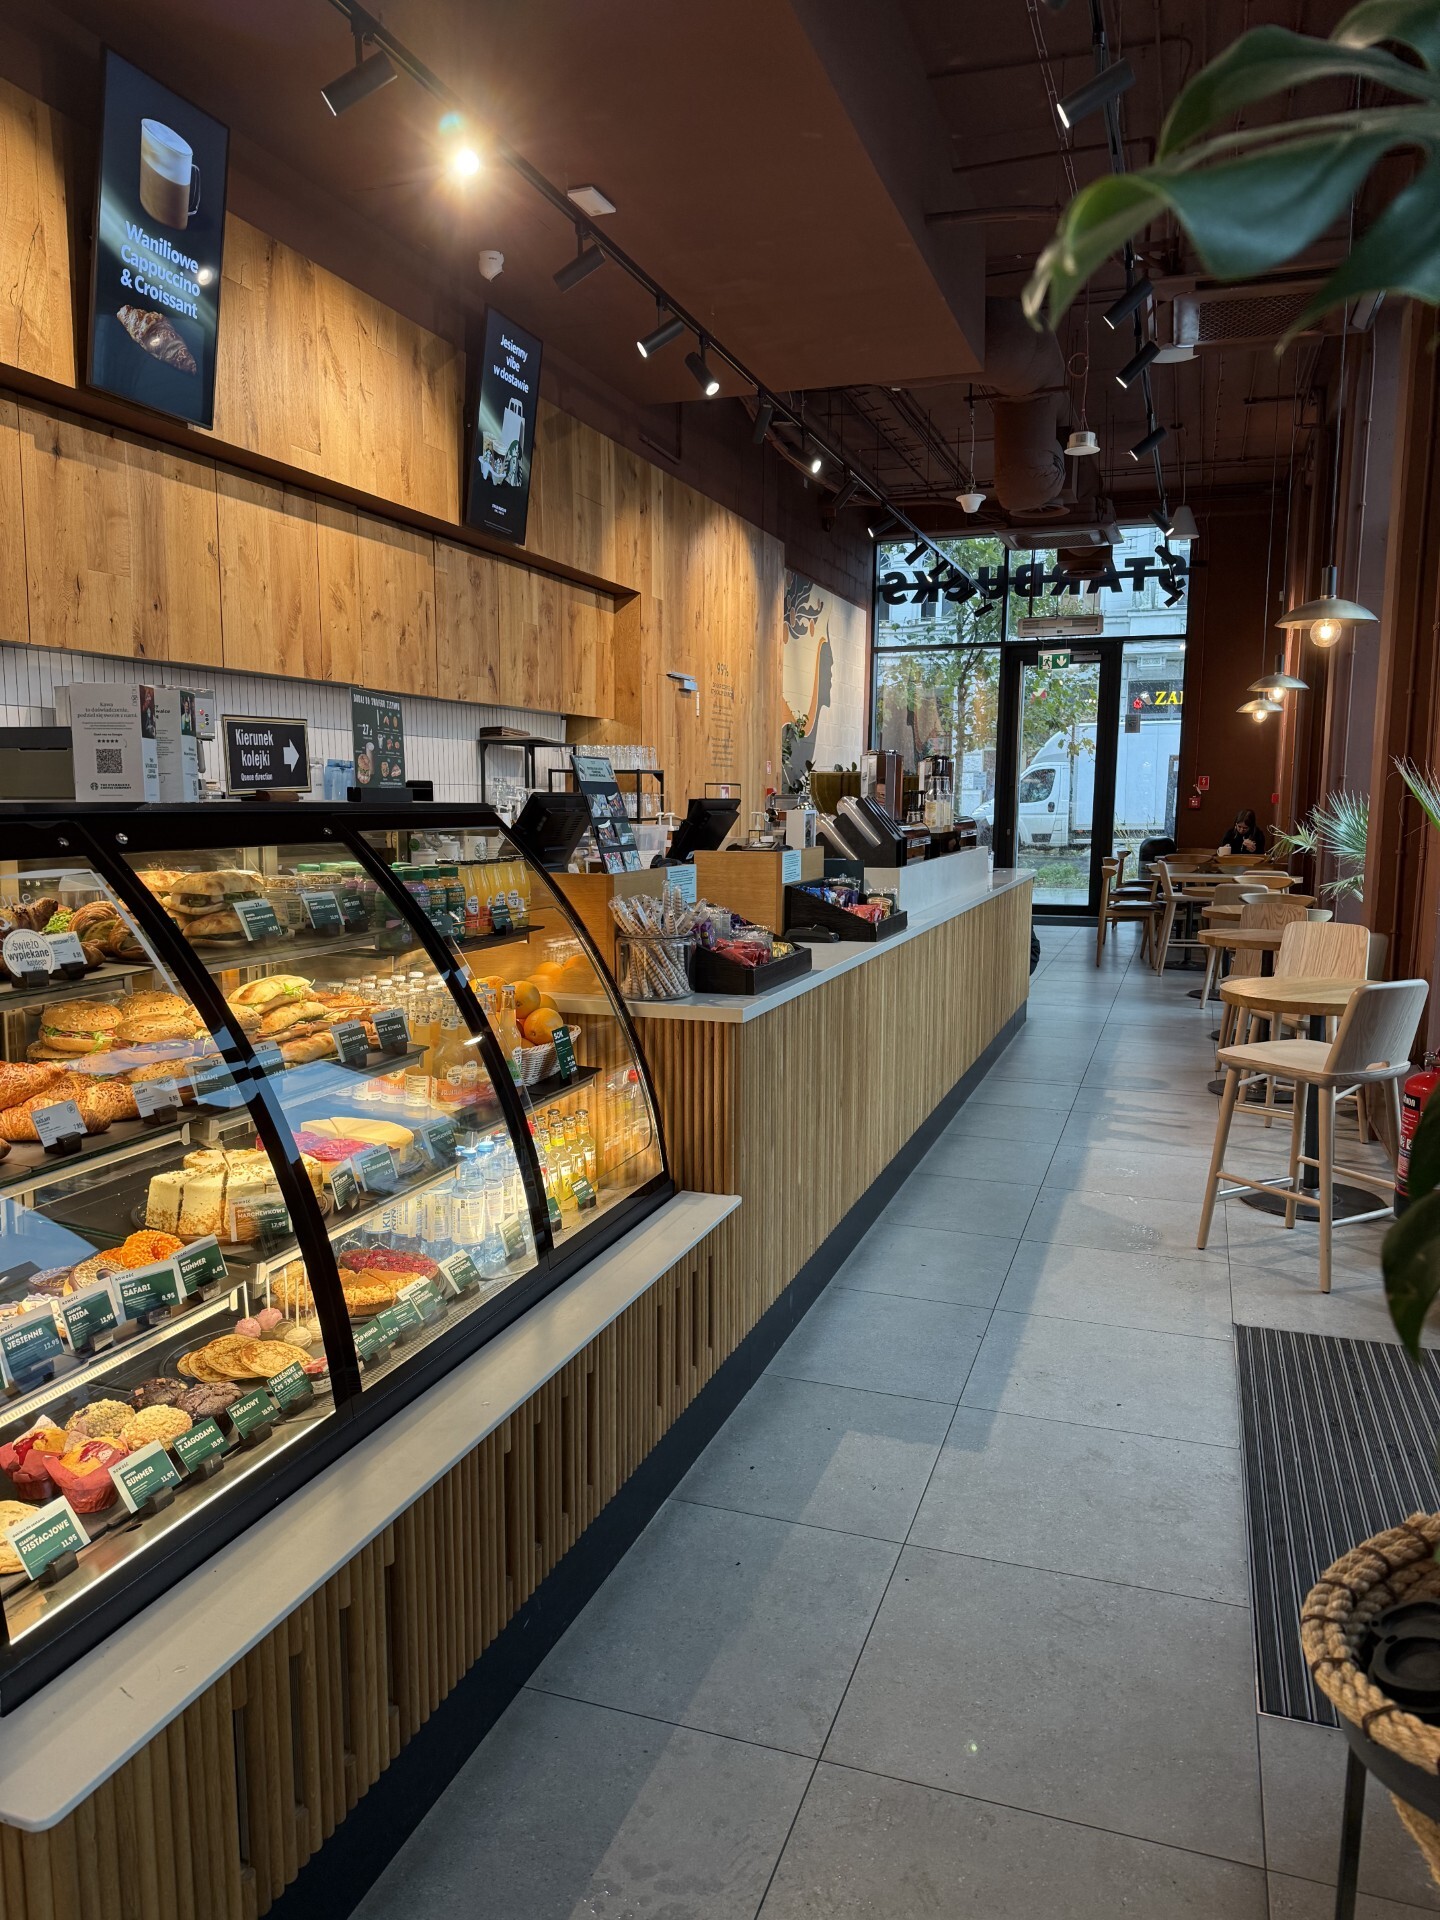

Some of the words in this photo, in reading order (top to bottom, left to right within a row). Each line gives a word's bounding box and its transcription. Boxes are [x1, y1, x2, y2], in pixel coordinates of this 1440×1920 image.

[125, 220, 199, 274] Waniliowe
[121, 244, 201, 297] Cappuccino
[120, 268, 133, 289] &
[134, 275, 198, 319] Croissant
[500, 334, 528, 363] Jesienny
[506, 355, 520, 372] vibe
[493, 364, 500, 376] w
[500, 367, 529, 393] dostawie
[1154, 690, 1184, 706] ZA
[235, 728, 274, 746] Kierunek
[241, 750, 270, 769] kolejki
[255, 773, 273, 781] direction
[12, 938, 39, 951] świeżo
[7, 948, 50, 962] wypiekane
[237, 1207, 286, 1219] MARCHEWKOWE
[181, 1257, 207, 1273] SUMMER
[123, 1283, 152, 1297] SAFARI
[161, 1292, 176, 1301] 8,95
[62, 1295, 79, 1305] NOWOŚĆ
[68, 1309, 90, 1323] FRIDA
[100, 1313, 114, 1324] 12,95
[6, 1327, 44, 1350] JESIENNE
[43, 1337, 60, 1351] 12,95
[231, 1397, 260, 1418] KAKAOWY
[178, 1444, 185, 1452] Z
[183, 1425, 216, 1449] JAGODAMI
[210, 1436, 224, 1448] 10,95
[125, 1465, 155, 1487] SUMMER
[160, 1470, 175, 1483] 11,95
[21, 1518, 70, 1554] PISTACJOWE
[60, 1533, 78, 1548] 11,95
